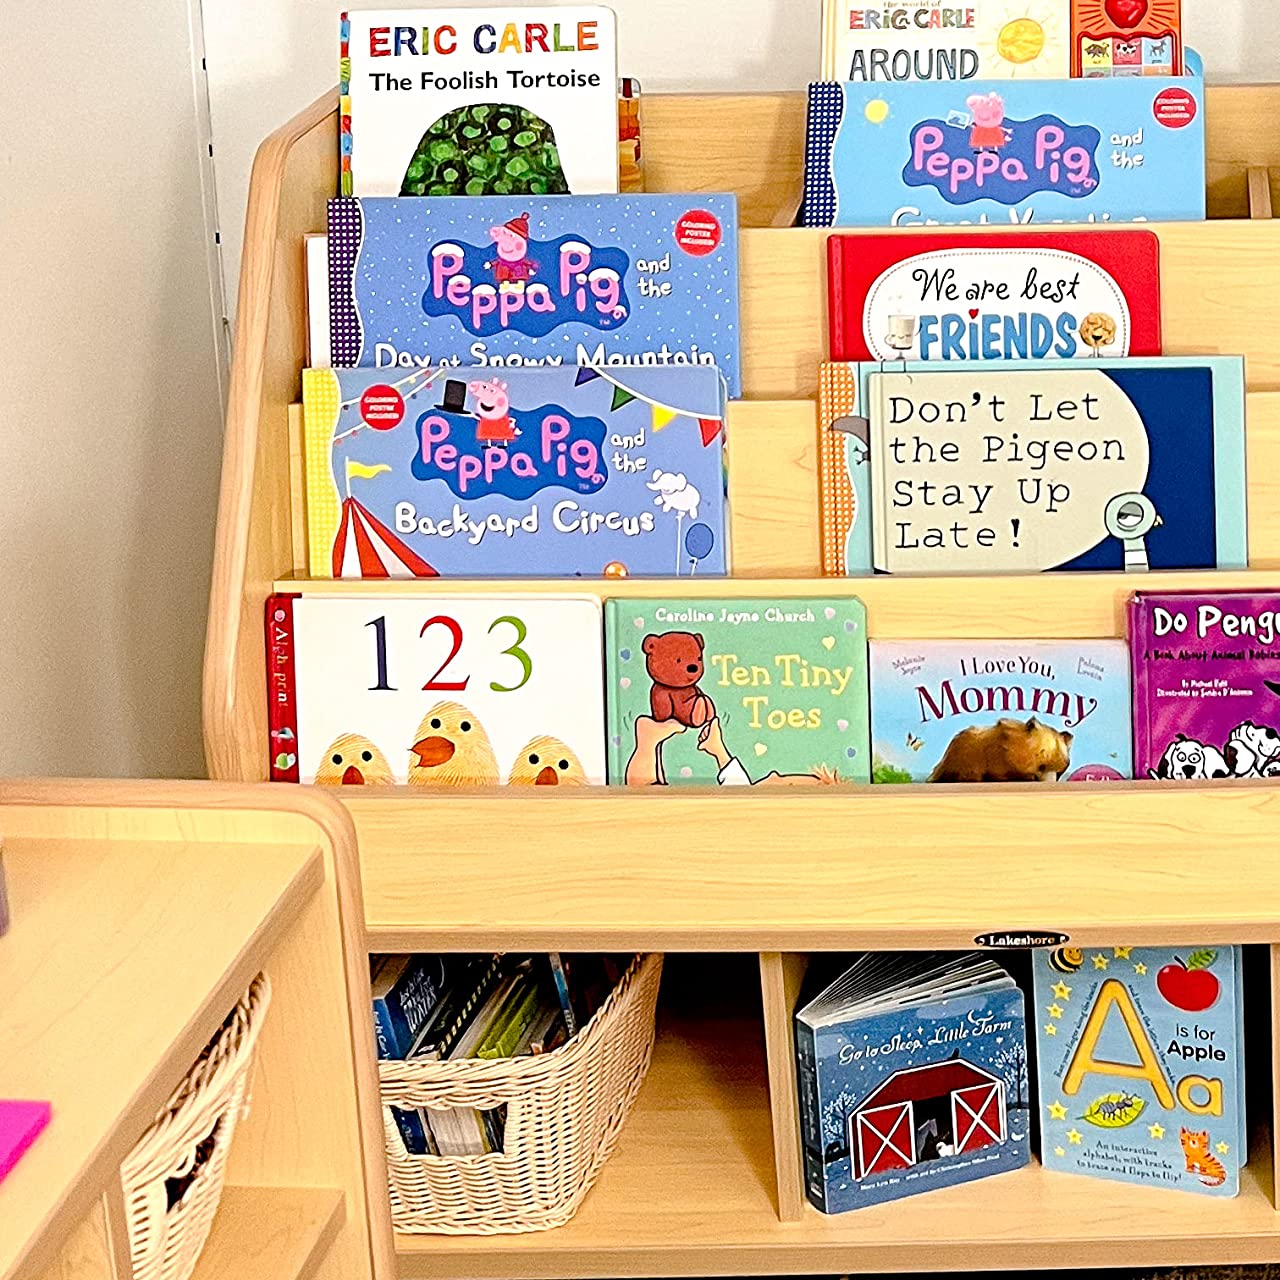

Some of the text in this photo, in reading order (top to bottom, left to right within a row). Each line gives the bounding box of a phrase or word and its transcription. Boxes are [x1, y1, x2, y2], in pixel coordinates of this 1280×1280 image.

[914, 8, 975, 29] CARLE
[369, 21, 599, 57] ERIC CARLE
[849, 48, 979, 81] AROUND
[369, 69, 600, 91] The Foolish Tortoise
[1110, 128, 1143, 146] and
[915, 126, 1097, 192] Peppa Pig
[1110, 150, 1143, 168] the
[637, 252, 671, 273] and
[432, 241, 627, 330] Peppa Pig
[638, 277, 672, 297] the
[912, 268, 1080, 303] We are best
[920, 310, 1078, 359] FRIENDS
[375, 343, 432, 368] Day
[470, 342, 563, 368] Snowy
[577, 342, 716, 368] Mountain
[889, 392, 1100, 424] Don't Let
[611, 429, 645, 447] and
[889, 433, 1125, 470] the Pigeon
[421, 416, 604, 493] Peppa Pig
[612, 452, 647, 472] the
[893, 479, 1070, 514] Stay Up
[395, 502, 655, 544] Backyard Circus
[895, 519, 1021, 549] Late!
[656, 608, 815, 625] Caroline Jayne Church
[1153, 607, 1187, 636] Do
[960, 656, 1055, 680] I Love You,
[1154, 650, 1173, 660] Book
[1180, 650, 1207, 661] About
[1212, 650, 1245, 660] Animal
[1249, 650, 1280, 660] Babies
[712, 654, 853, 695] Ten Tiny
[743, 696, 821, 729] Toes
[915, 679, 1097, 728] Mommy
[989, 935, 1055, 946] Lakeshore
[839, 1045, 862, 1065] Go
[866, 1044, 878, 1057] to
[928, 1022, 968, 1045] Little
[971, 1015, 1012, 1036] Farm
[1176, 1024, 1215, 1041] is for
[1167, 1040, 1226, 1062] Apple
